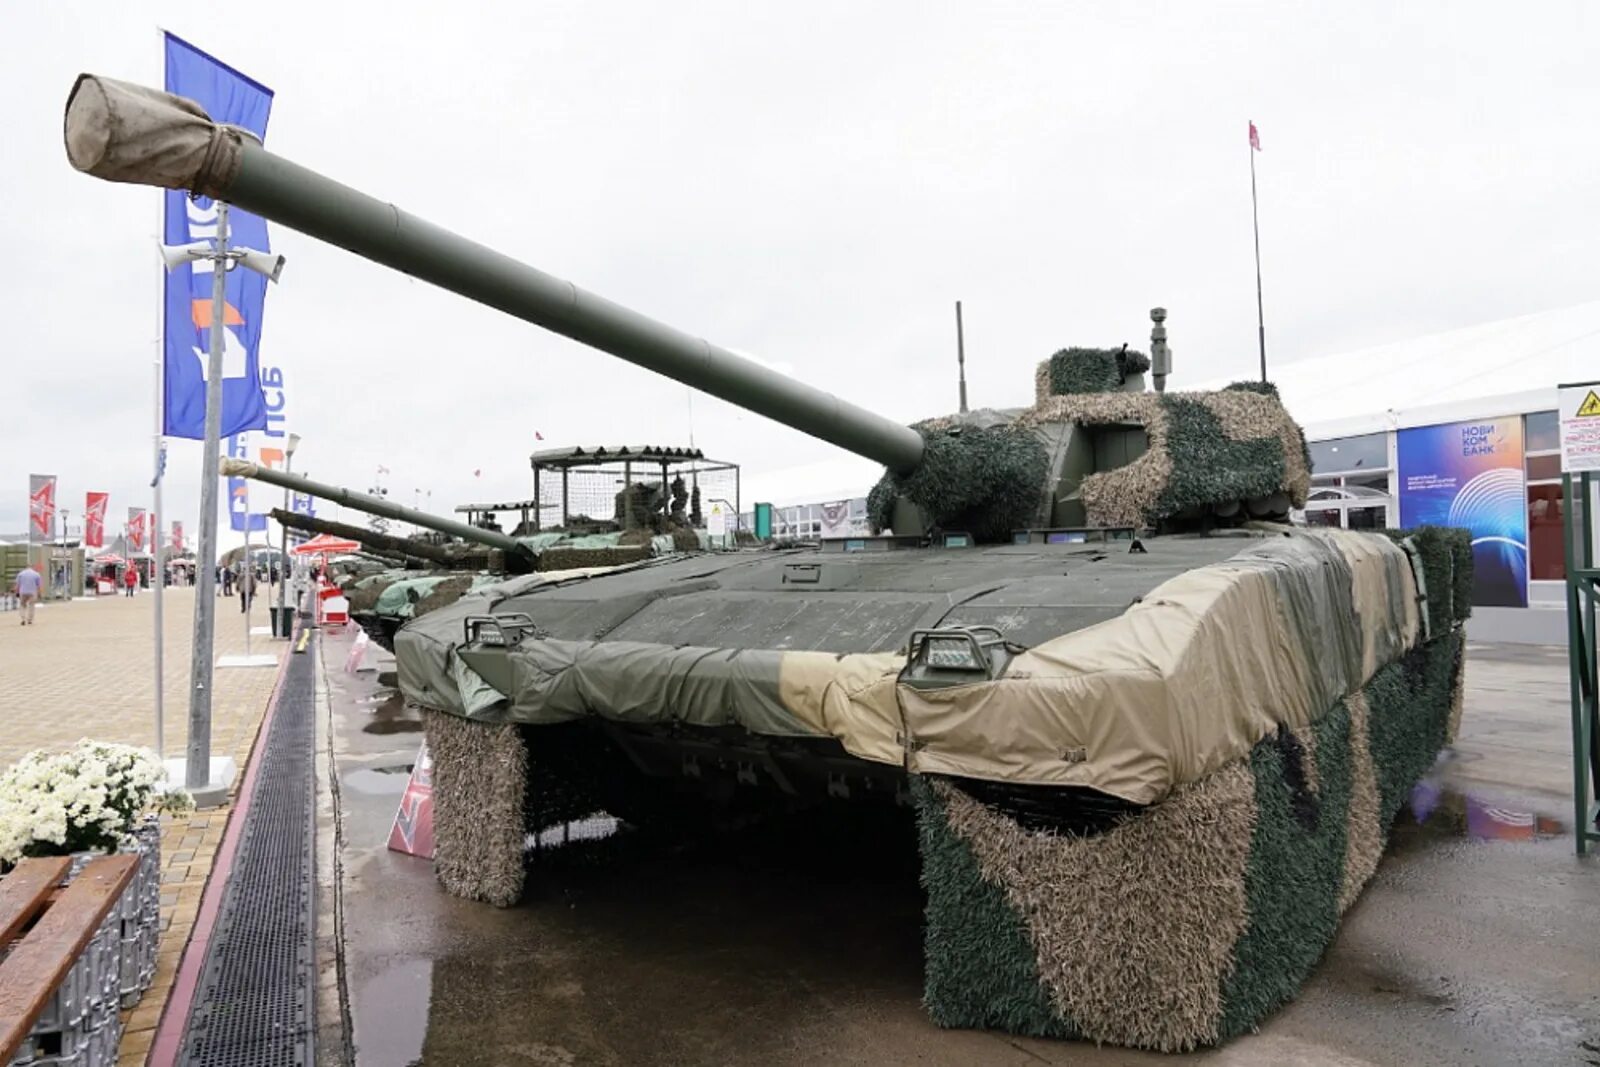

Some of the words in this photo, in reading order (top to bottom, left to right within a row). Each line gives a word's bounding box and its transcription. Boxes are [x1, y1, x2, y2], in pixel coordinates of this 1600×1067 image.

[262, 366, 286, 438] ПСБ
[1462, 425, 1495, 437] НОВИ
[1463, 435, 1488, 447] КОМ
[1463, 445, 1494, 456] БАНК
